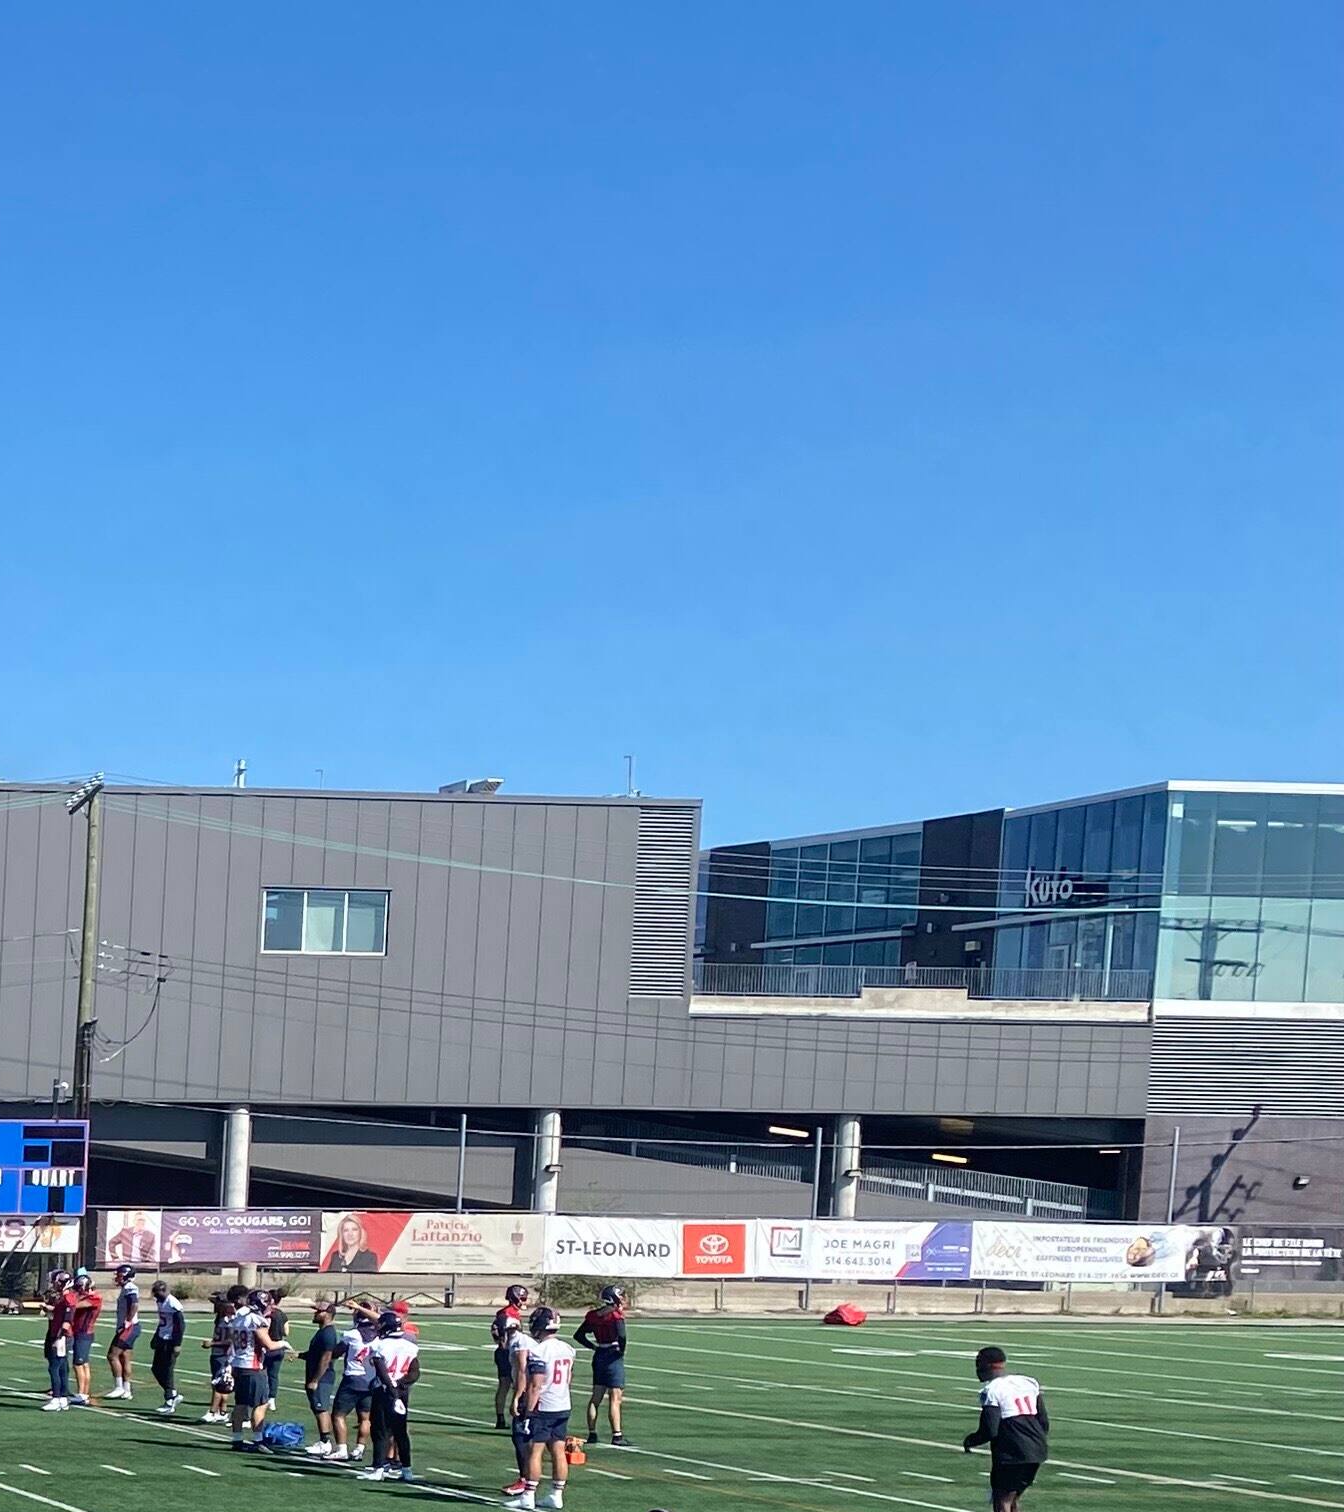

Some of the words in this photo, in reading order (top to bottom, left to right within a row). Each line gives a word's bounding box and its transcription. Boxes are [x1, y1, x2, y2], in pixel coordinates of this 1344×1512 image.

[31, 1169, 76, 1186] QUART
[179, 1217, 200, 1227] GO,
[226, 1216, 287, 1227] COUGARS,
[289, 1216, 311, 1226] GO!
[412, 1229, 482, 1242] Lattanzio
[823, 1239, 848, 1249] JOE
[853, 1240, 896, 1250] MAGRI
[1242, 1238, 1252, 1247] LE
[1285, 1239, 1302, 1248] FILE
[1242, 1247, 1252, 1256] LA
[694, 1255, 734, 1264] TOYOTA
[386, 1355, 411, 1377] 44
[553, 1358, 571, 1385] 67
[1014, 1395, 1033, 1414] 11
